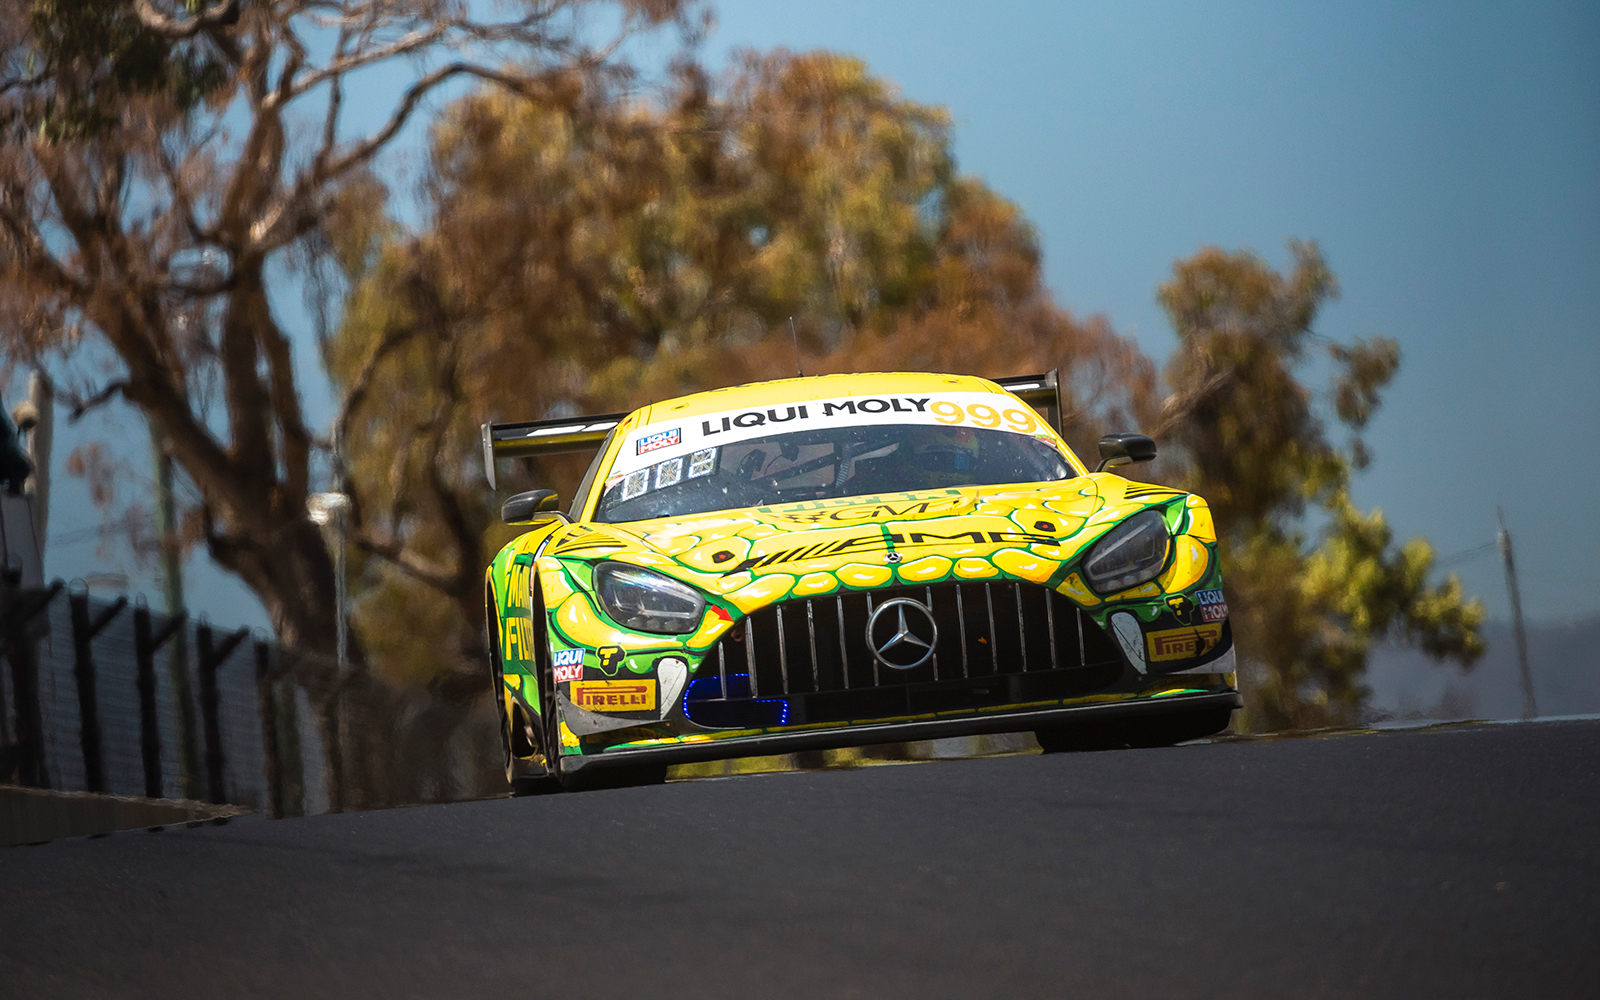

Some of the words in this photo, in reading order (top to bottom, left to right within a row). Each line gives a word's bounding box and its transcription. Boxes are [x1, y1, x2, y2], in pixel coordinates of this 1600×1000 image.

[702, 405, 806, 436] LIQUI
[822, 397, 931, 416] MOLY
[930, 401, 1037, 434] 999
[640, 428, 679, 447] LIQUI
[640, 437, 679, 454] MOLY
[1154, 630, 1217, 656] PIRELI
[553, 649, 583, 667] LIQUI
[553, 664, 582, 681] MOLY
[576, 685, 648, 706] PIRELLI
